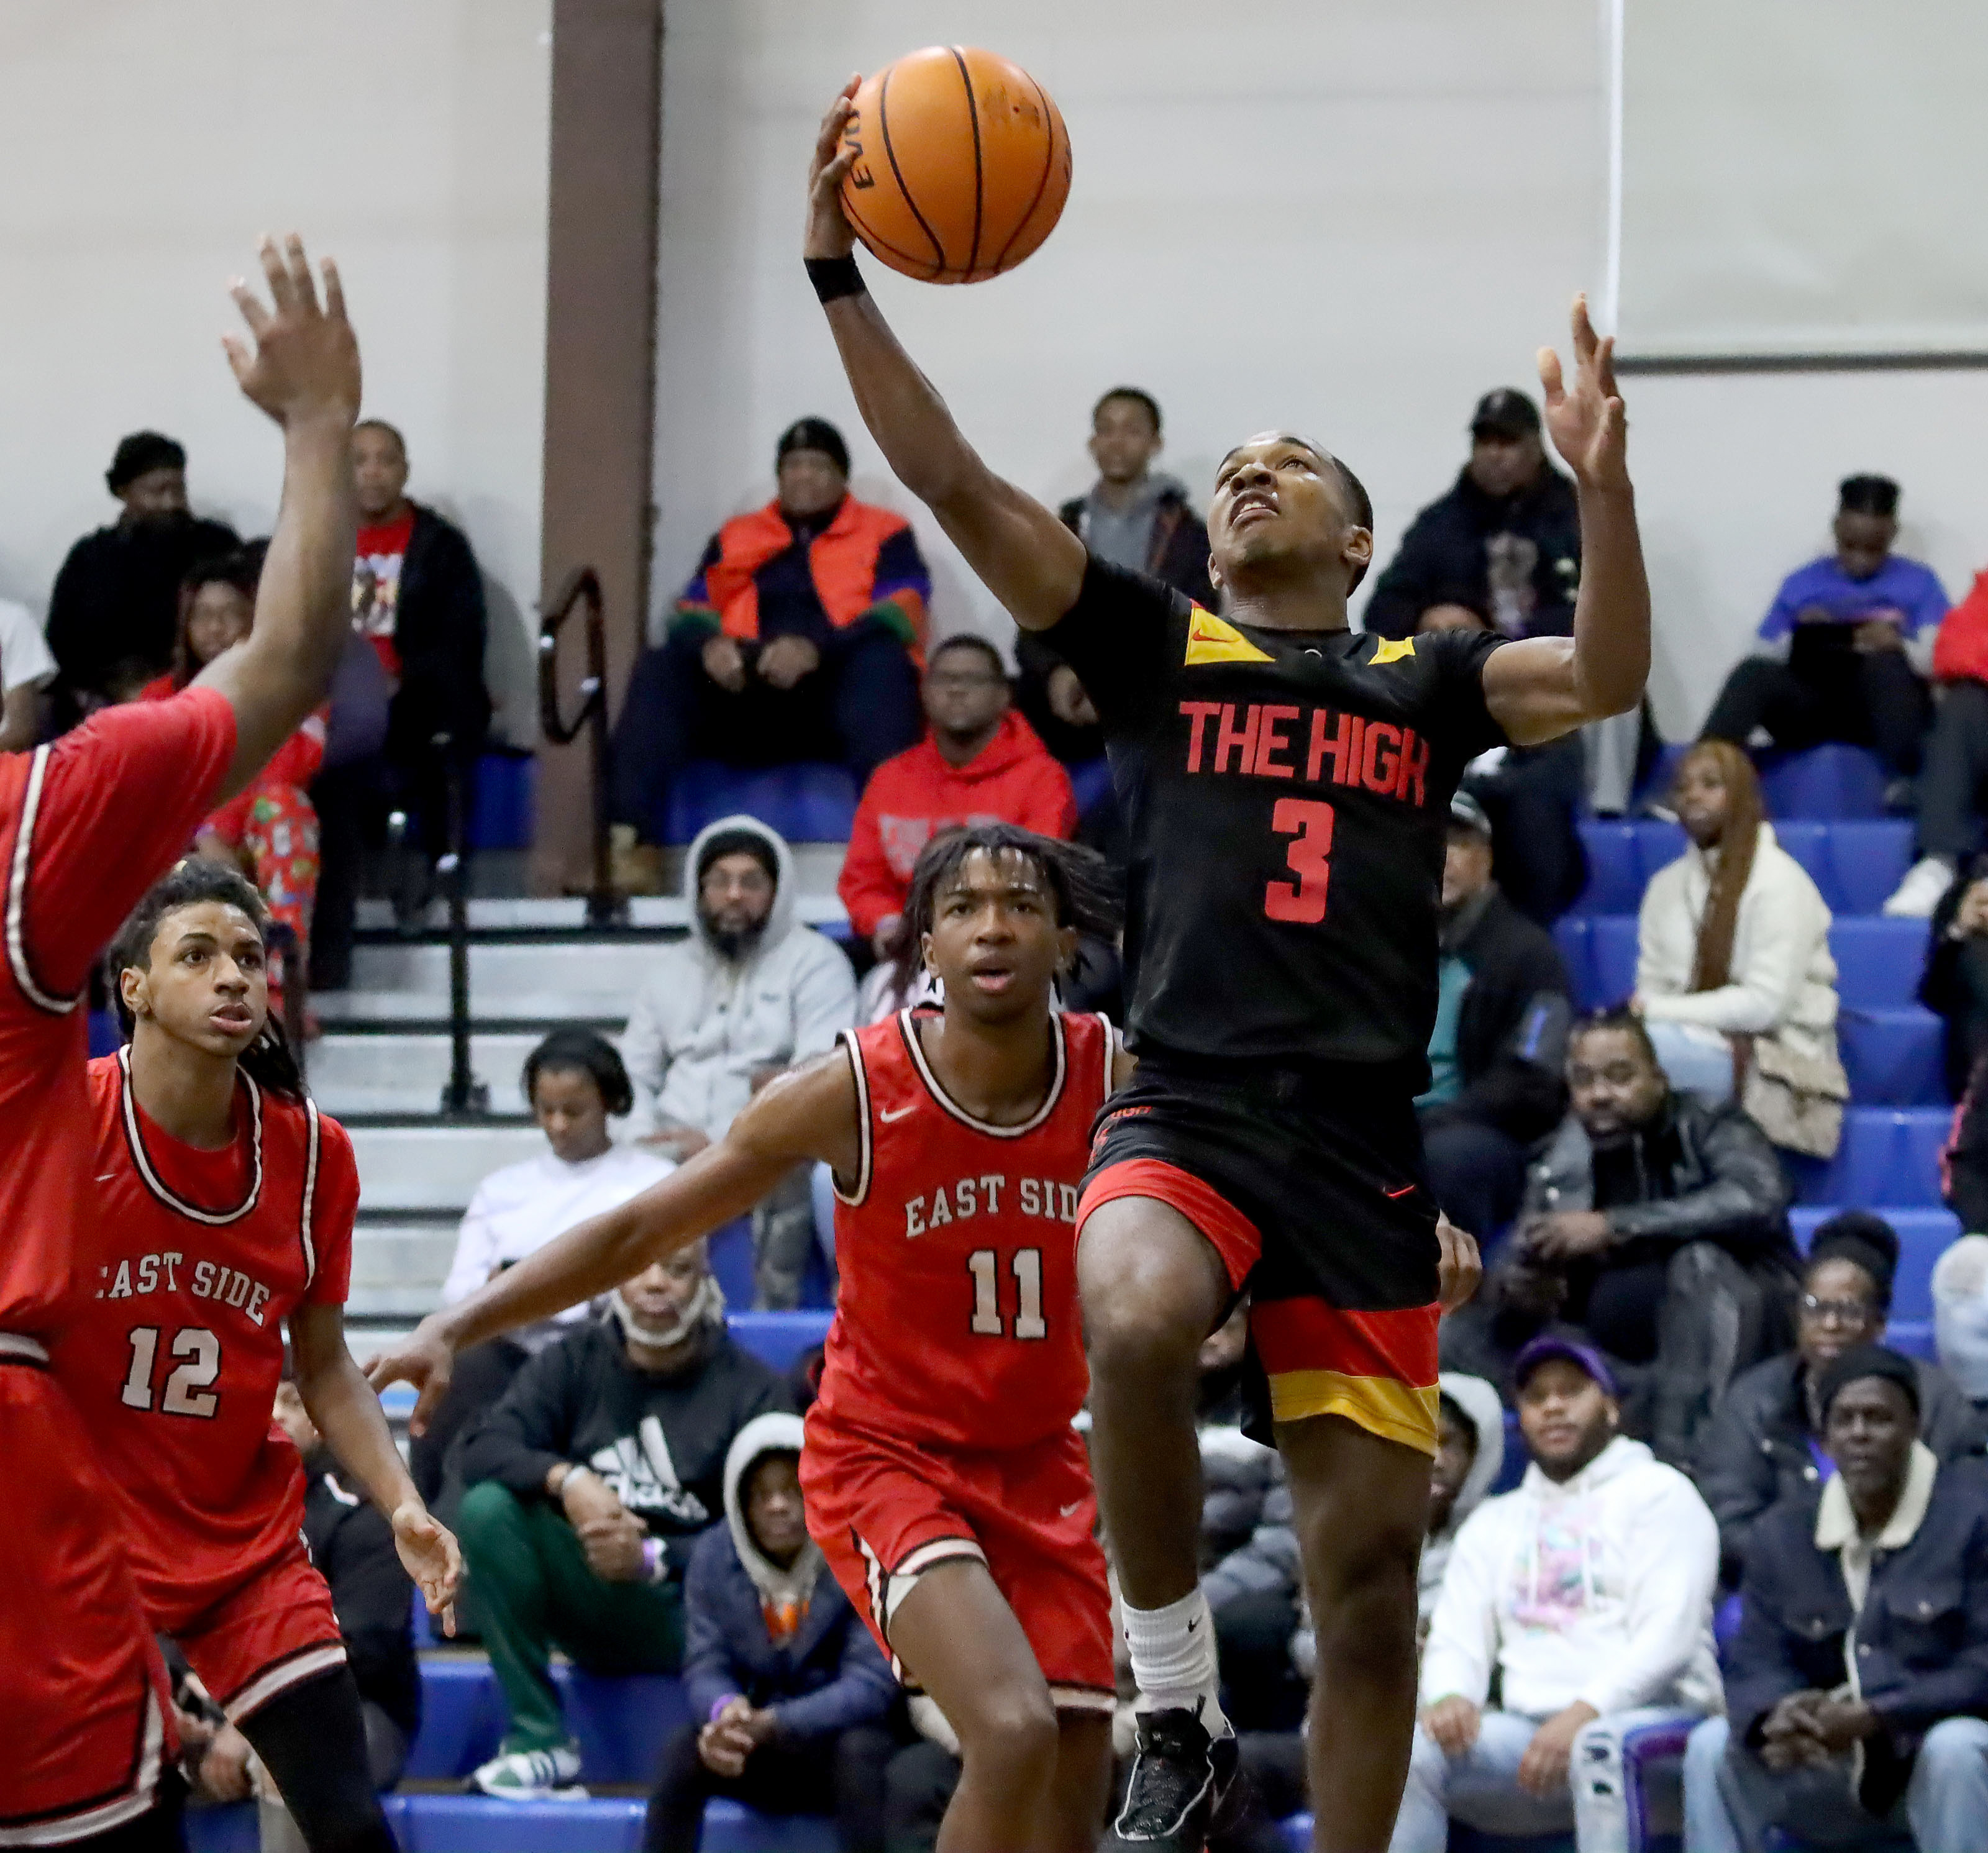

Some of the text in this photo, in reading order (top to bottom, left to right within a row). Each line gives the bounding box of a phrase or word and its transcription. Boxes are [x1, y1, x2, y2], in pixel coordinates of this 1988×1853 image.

[1180, 702, 1428, 806] THE HIGH
[1265, 798, 1334, 923] 3
[905, 1175, 1005, 1238] EAST
[191, 1260, 270, 1326] SIDE
[969, 1249, 1046, 1339] 11
[122, 1327, 219, 1418] 12
